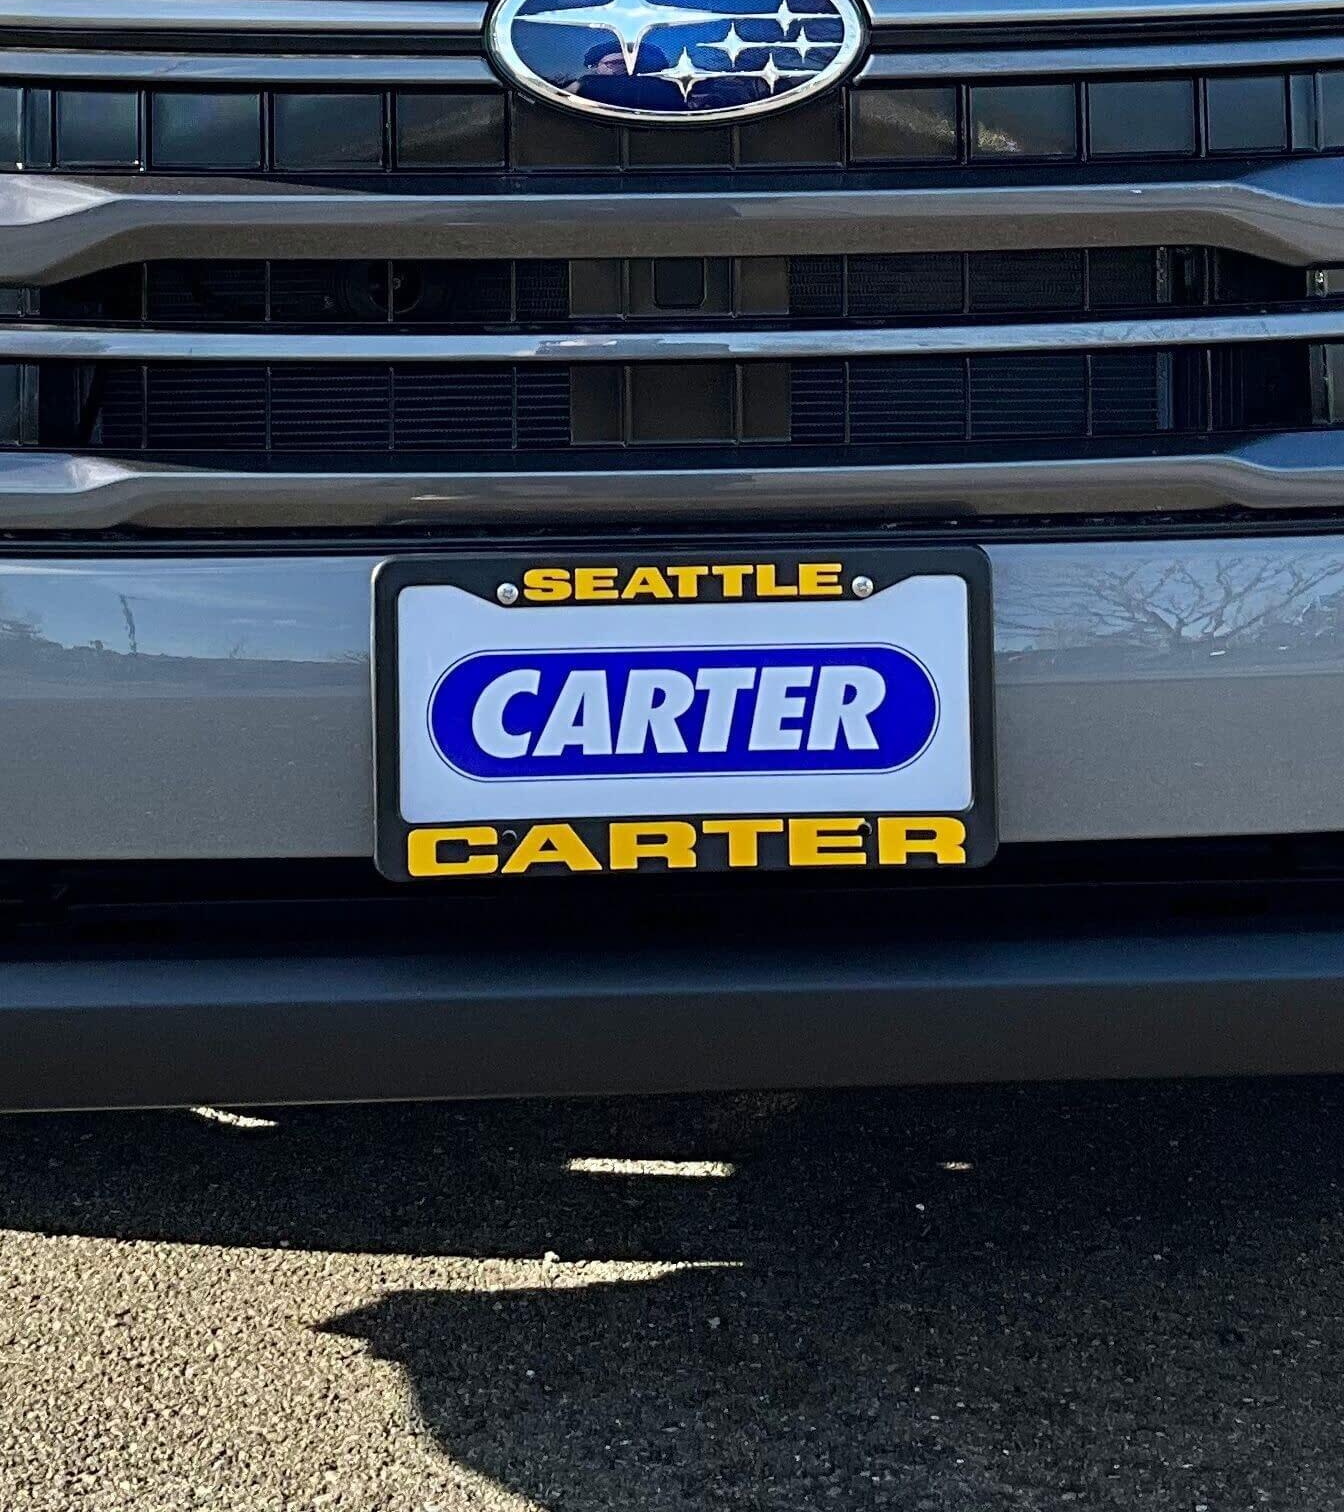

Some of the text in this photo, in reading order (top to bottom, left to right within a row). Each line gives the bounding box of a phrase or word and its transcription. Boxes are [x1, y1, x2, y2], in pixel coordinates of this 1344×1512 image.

[522, 563, 843, 602] SEATTLE
[471, 665, 887, 759] CARTER
[406, 817, 967, 877] CARTER
